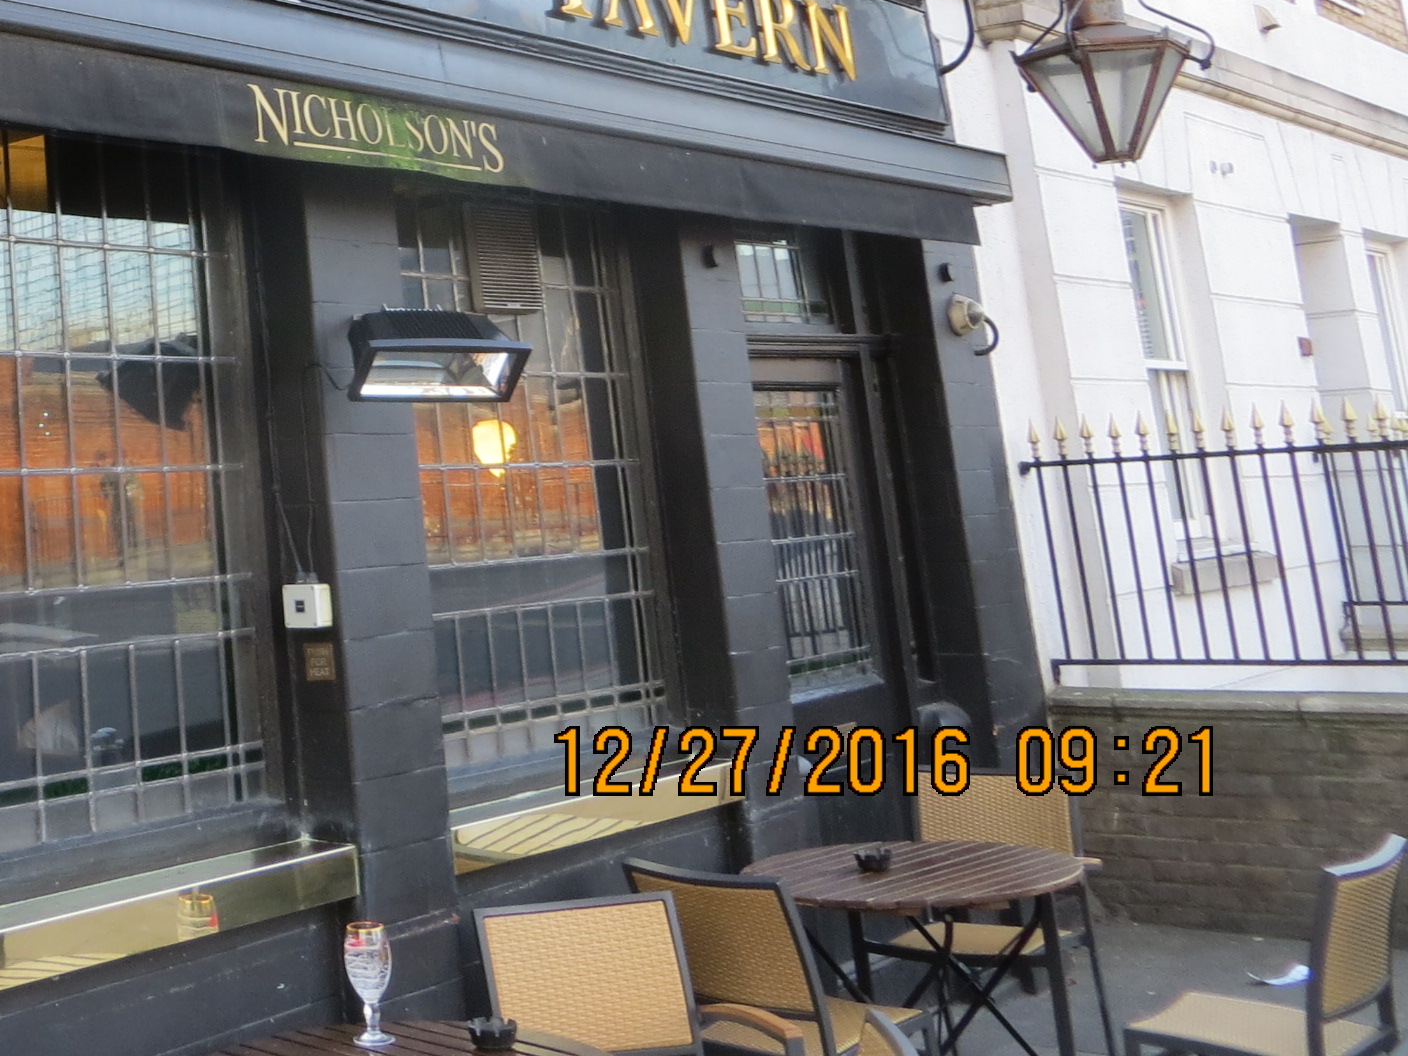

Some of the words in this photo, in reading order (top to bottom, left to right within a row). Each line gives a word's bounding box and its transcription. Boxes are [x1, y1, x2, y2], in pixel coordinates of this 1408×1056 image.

[247, 84, 505, 174] NICHOLSON'S
[310, 658, 328, 666] FOR
[309, 667, 330, 677] HEAT
